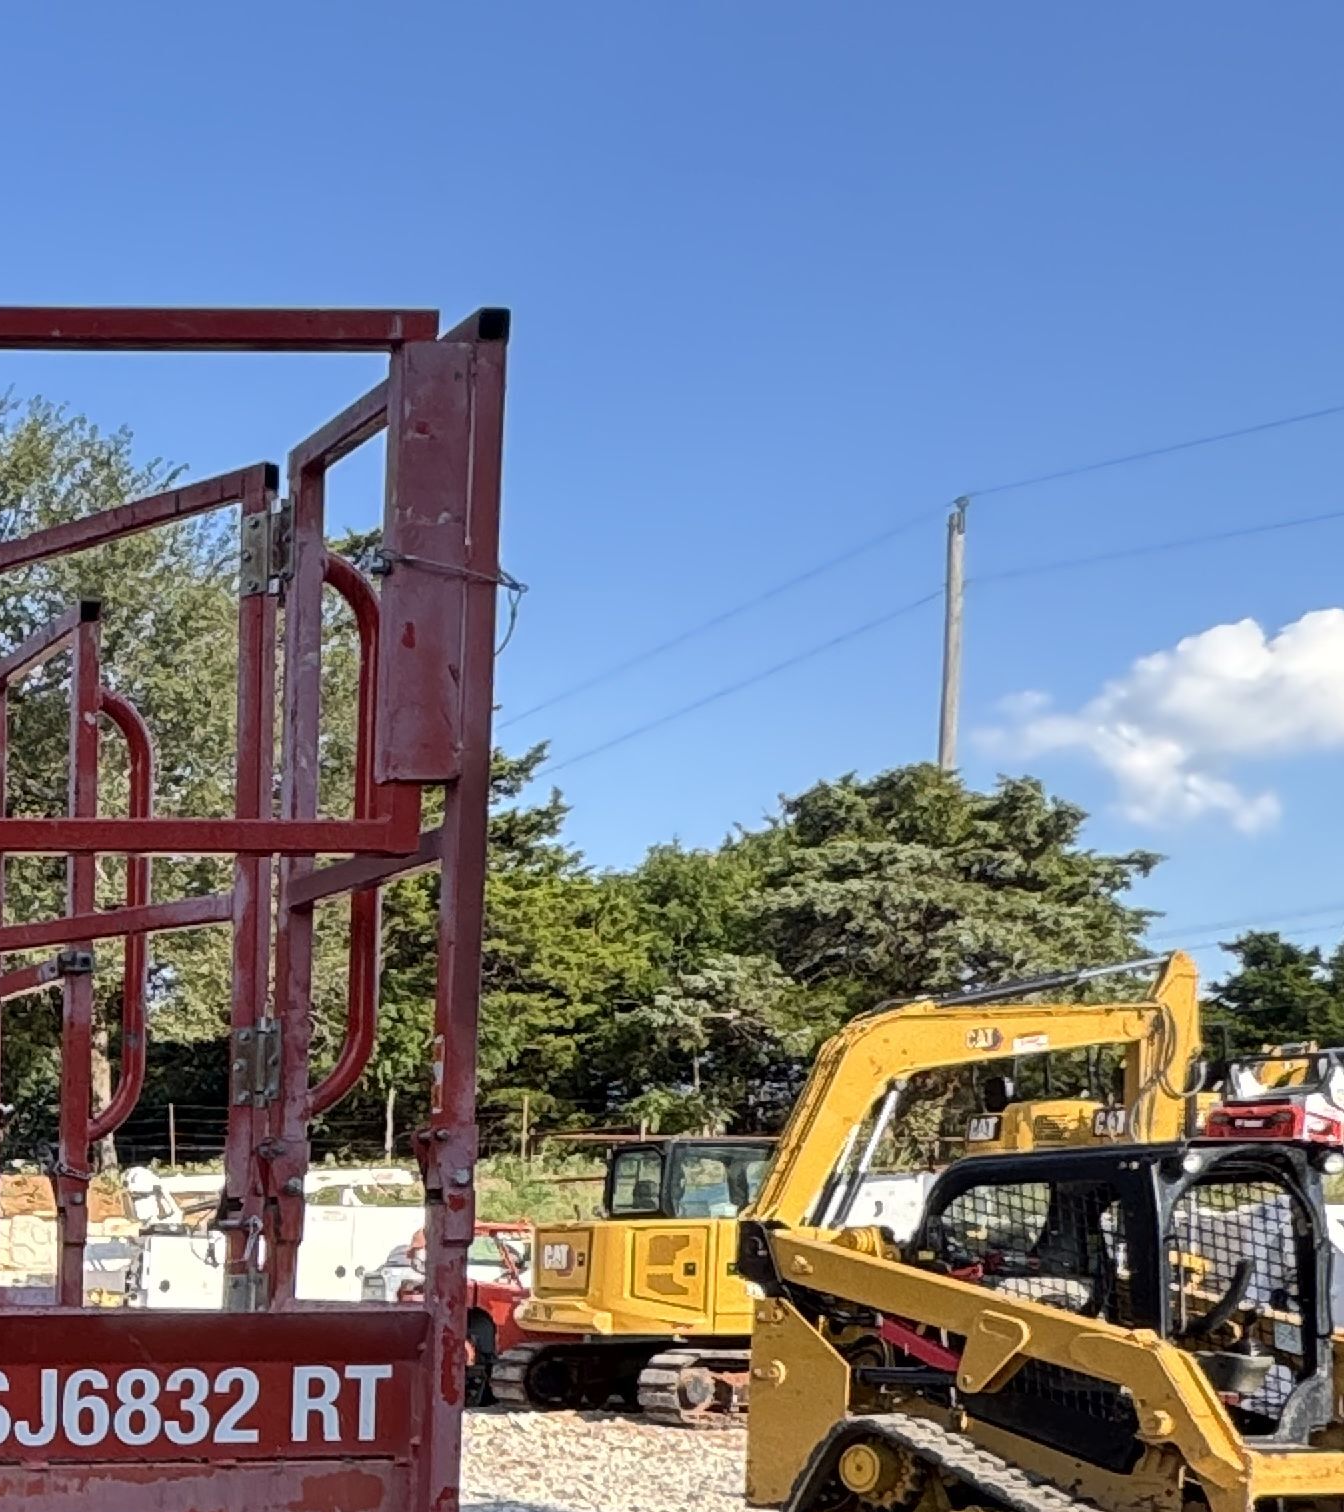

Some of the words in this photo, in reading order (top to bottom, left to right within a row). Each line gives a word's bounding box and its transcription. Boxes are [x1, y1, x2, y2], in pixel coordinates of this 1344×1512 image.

[967, 1028, 994, 1049] CAT
[544, 1244, 569, 1270] CAT
[290, 1364, 393, 1442] RT
